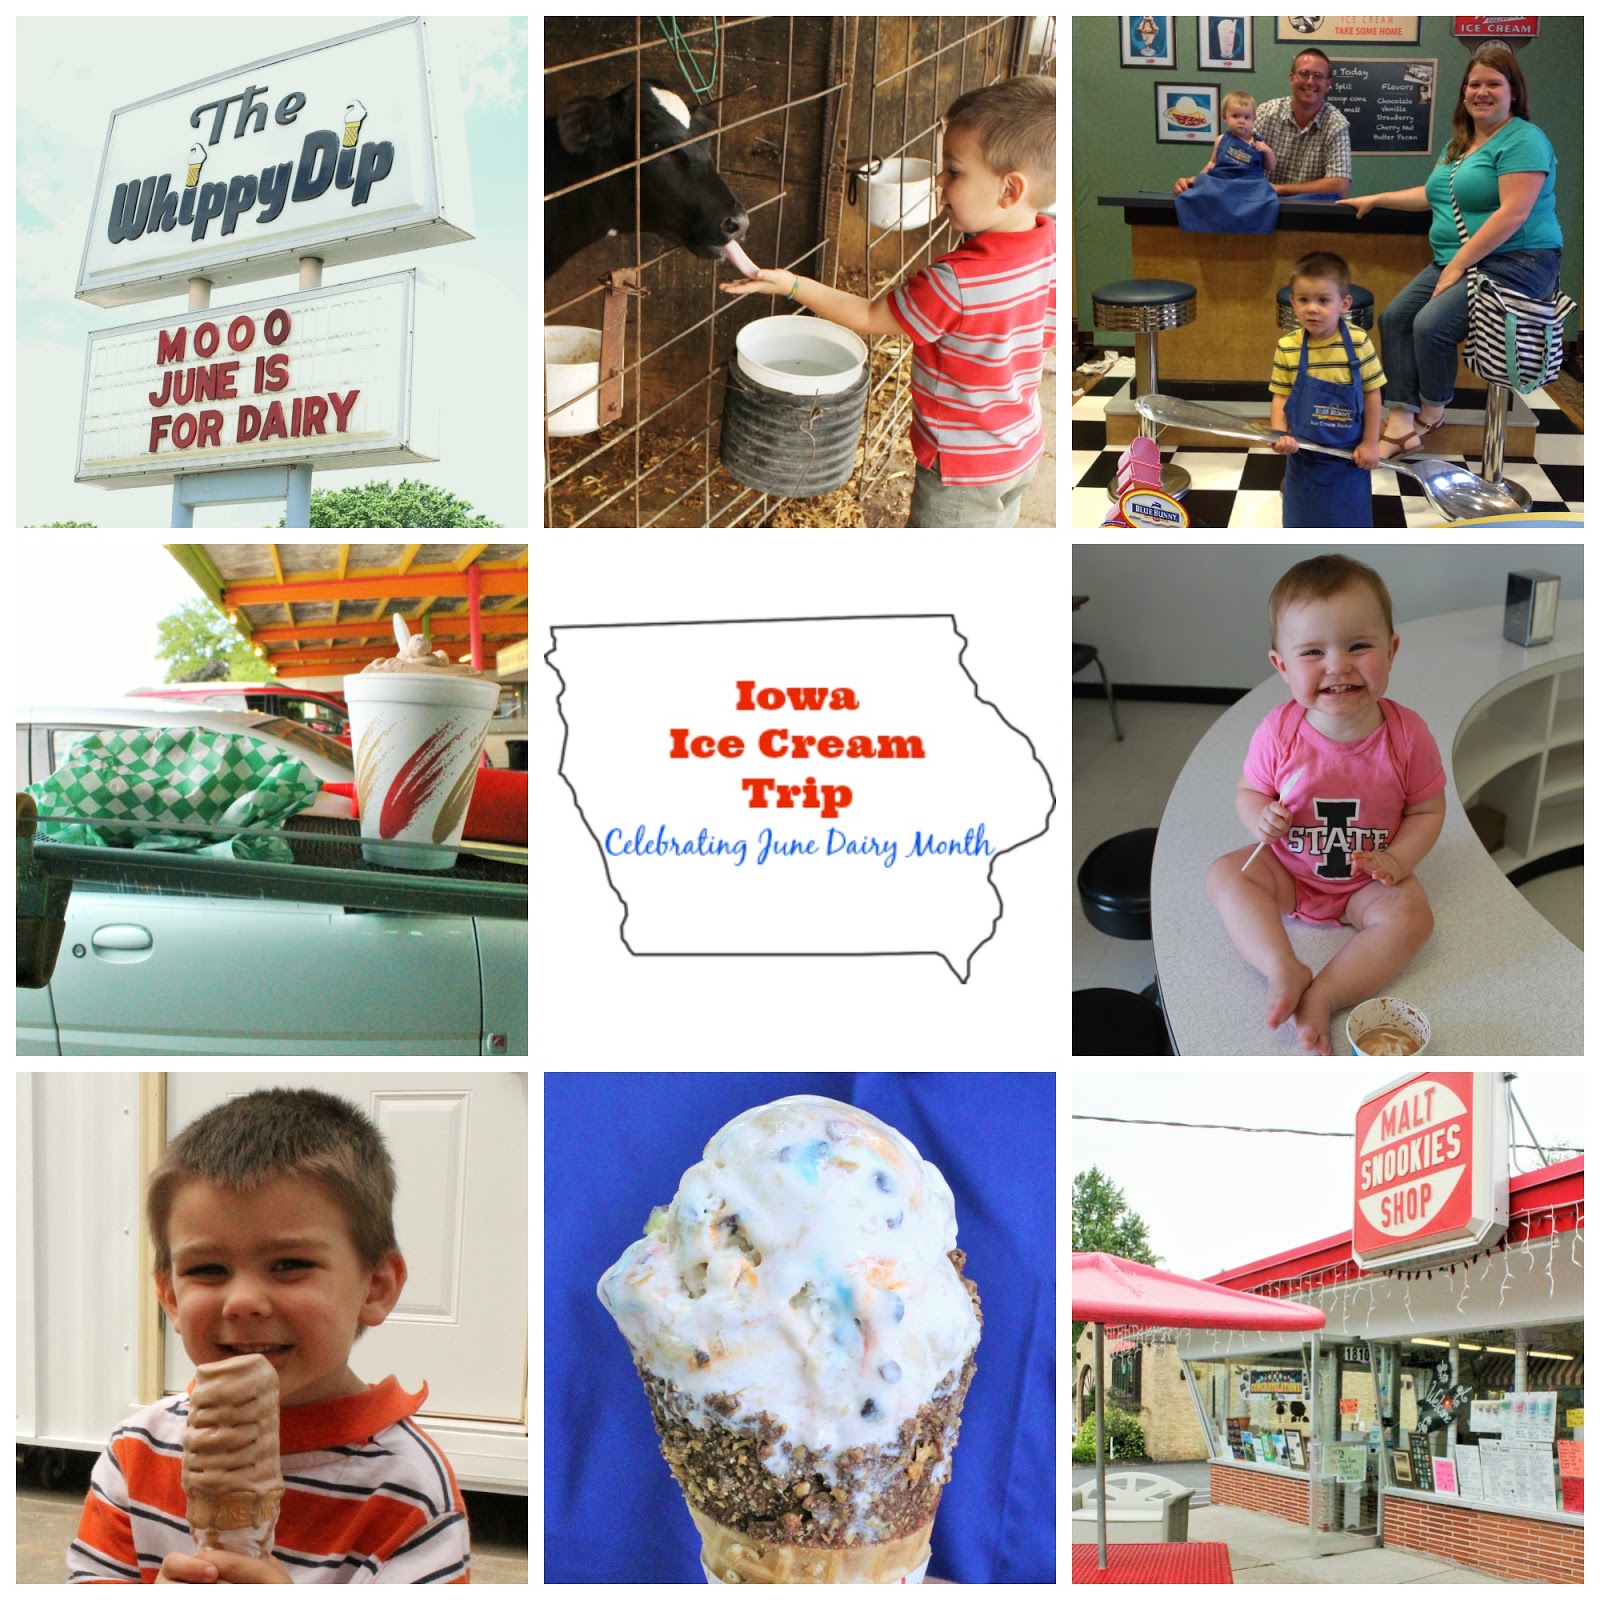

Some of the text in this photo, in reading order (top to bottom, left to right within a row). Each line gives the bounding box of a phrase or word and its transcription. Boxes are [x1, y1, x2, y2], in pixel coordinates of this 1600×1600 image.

[1341, 16, 1394, 25] ICE CREAM
[1335, 27, 1403, 36] TAKE SOME HOME
[1461, 24, 1532, 33] ICE CREAM
[1340, 67, 1369, 79] Today
[1335, 83, 1352, 93] Split
[1381, 83, 1414, 91] Flavors
[190, 85, 307, 146] The
[1376, 114, 1414, 123] Strawberry
[1376, 124, 1400, 133] Cherry
[156, 308, 292, 366] MOOO
[148, 353, 290, 409] JUNE IS
[149, 389, 361, 453] FOR DAIRY
[1135, 504, 1153, 516] BLUE
[1153, 509, 1178, 521] BUNNY
[1287, 826, 1389, 856] STATE
[1380, 1086, 1436, 1142] MALT
[1361, 1123, 1462, 1191] SNOOKIES
[1380, 1182, 1432, 1228] SHOP
[1345, 1347, 1370, 1361] 1810
